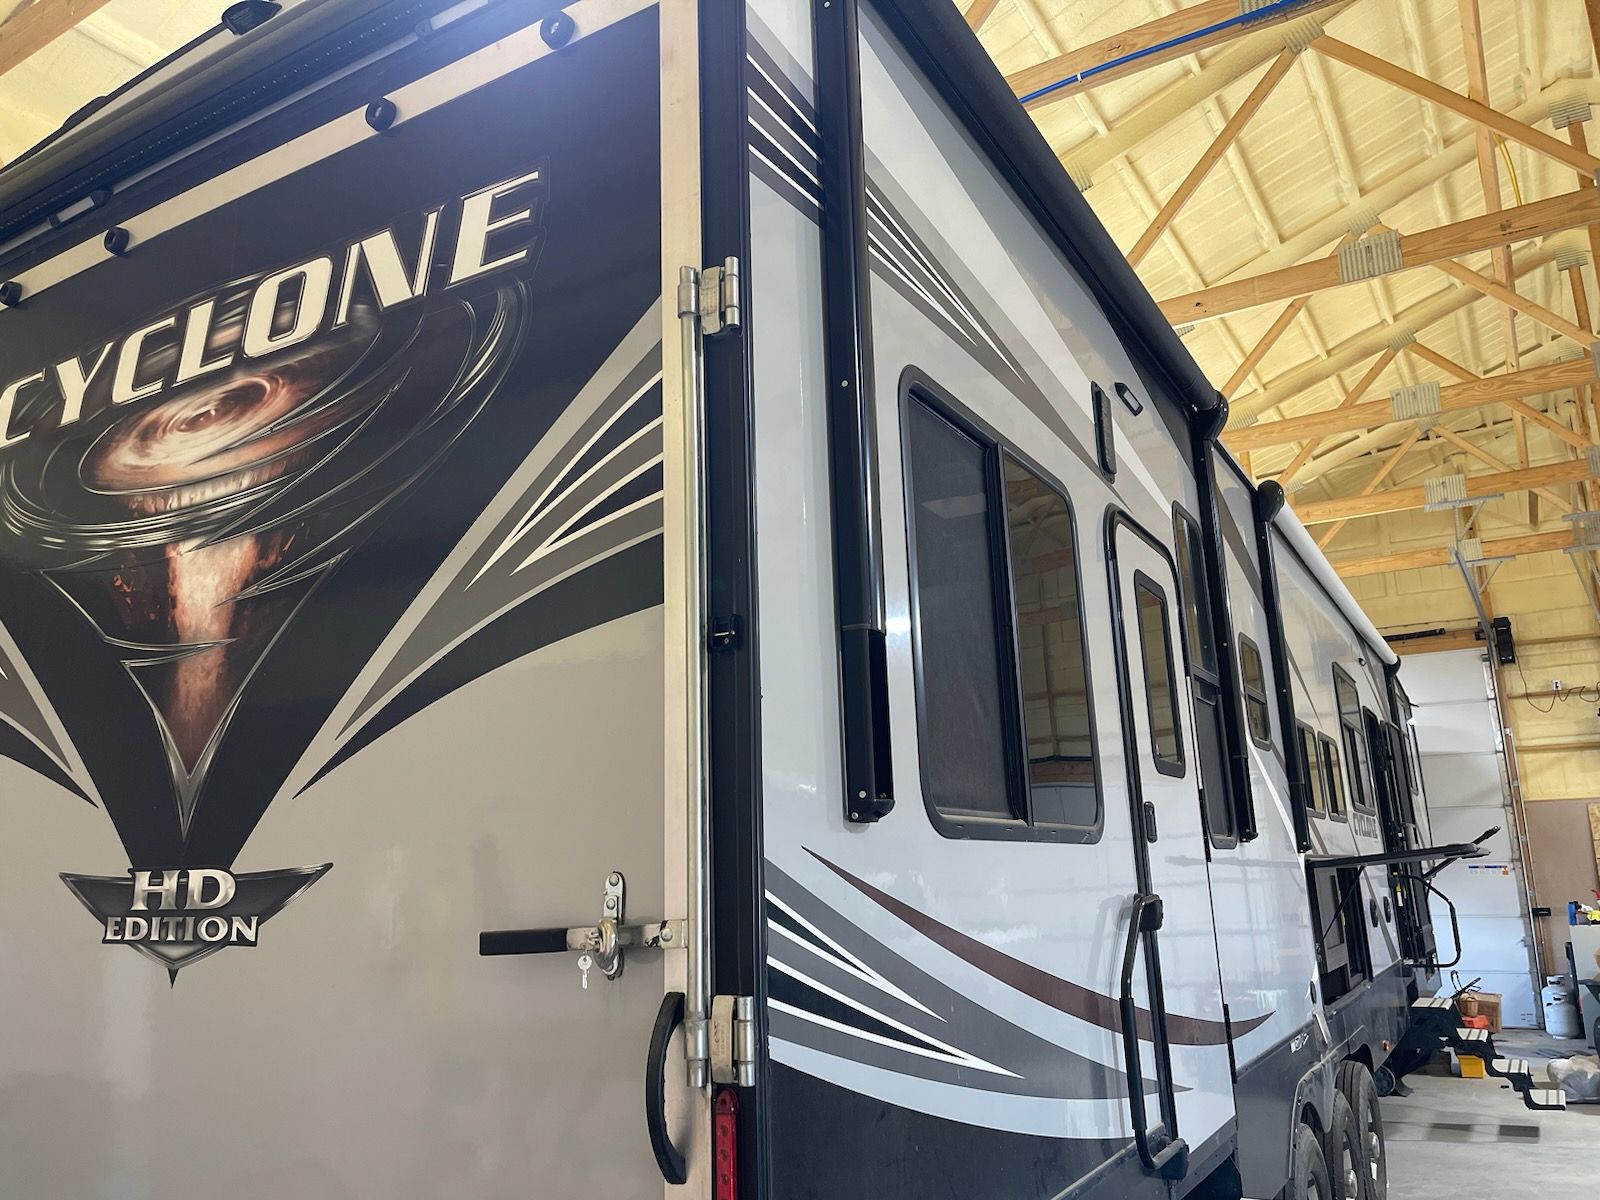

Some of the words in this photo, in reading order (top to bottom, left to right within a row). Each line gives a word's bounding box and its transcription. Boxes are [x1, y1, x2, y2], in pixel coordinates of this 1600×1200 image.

[0, 169, 541, 449] CYCLONE
[129, 868, 237, 911] HD
[104, 915, 259, 942] EDITION
